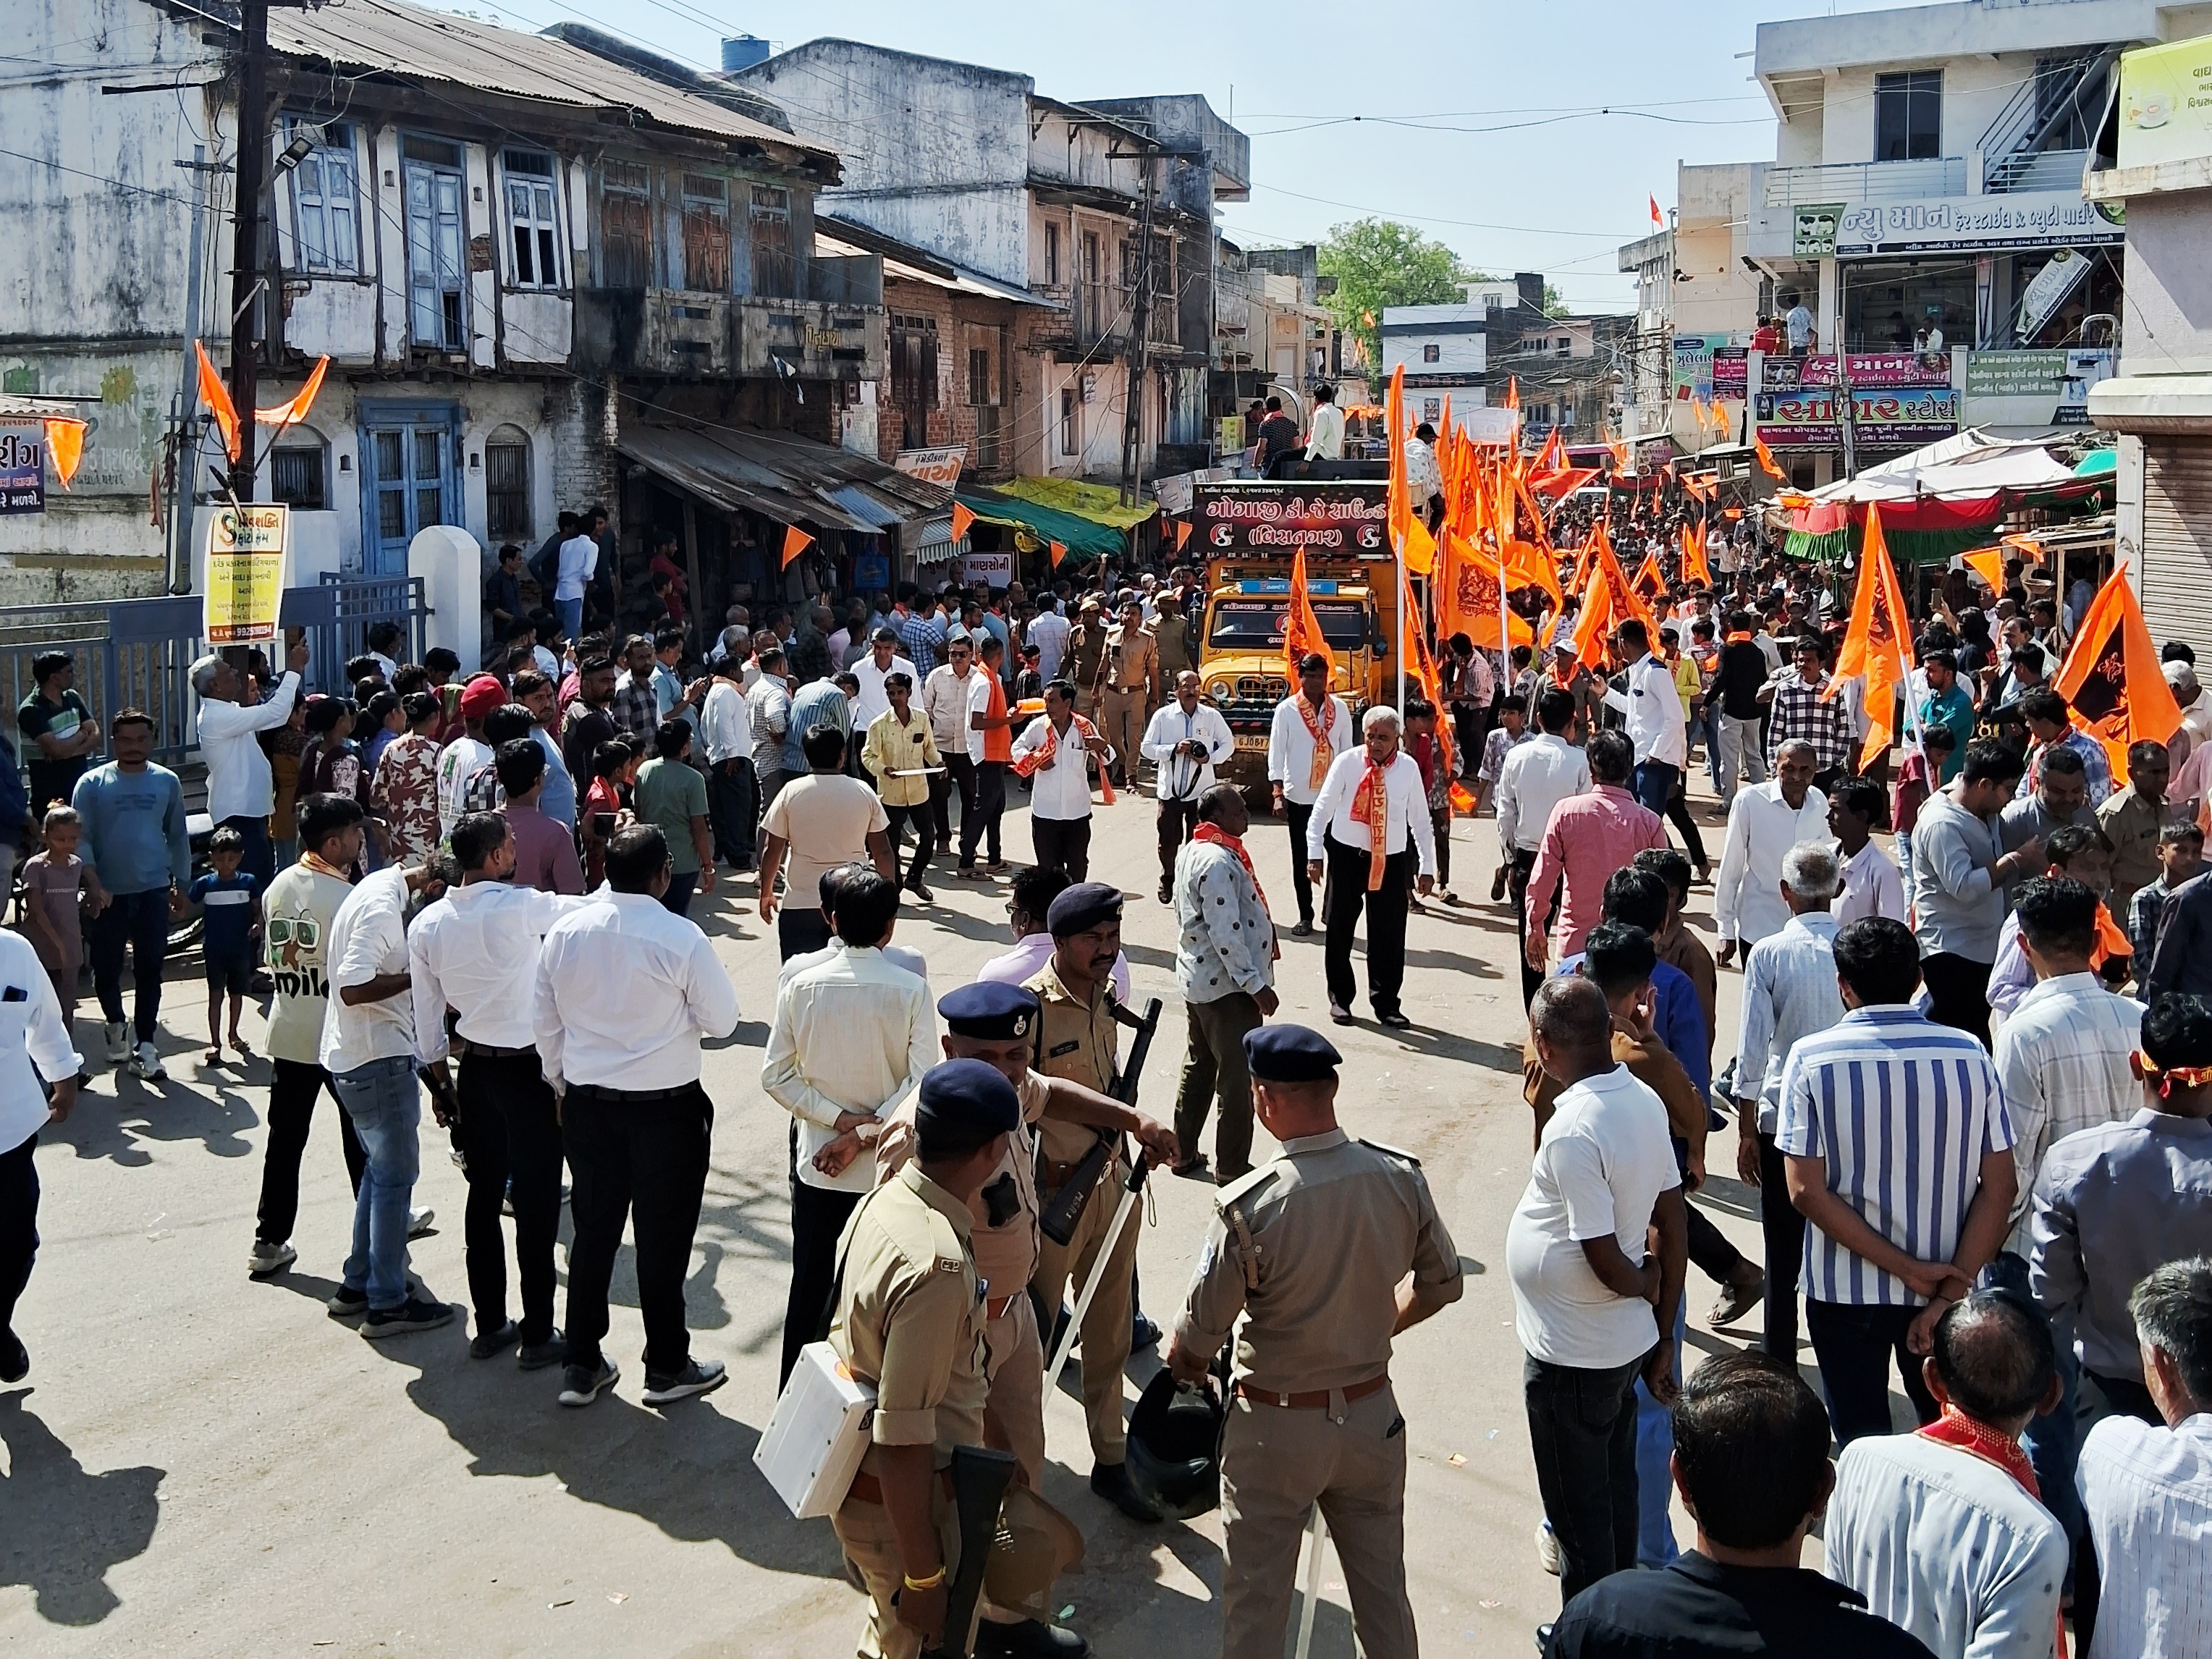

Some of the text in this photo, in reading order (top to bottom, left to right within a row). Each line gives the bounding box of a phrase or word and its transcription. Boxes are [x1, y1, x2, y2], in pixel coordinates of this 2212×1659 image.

[1844, 208, 1883, 241] ન્યુ
[1890, 205, 1950, 229] માન
[2015, 211, 2026, 228] &
[1852, 360, 1903, 371] માન
[12, 490, 41, 507] મળશે.
[1206, 495, 1283, 520] ગોગાજી
[970, 557, 1009, 571] માણસોની
